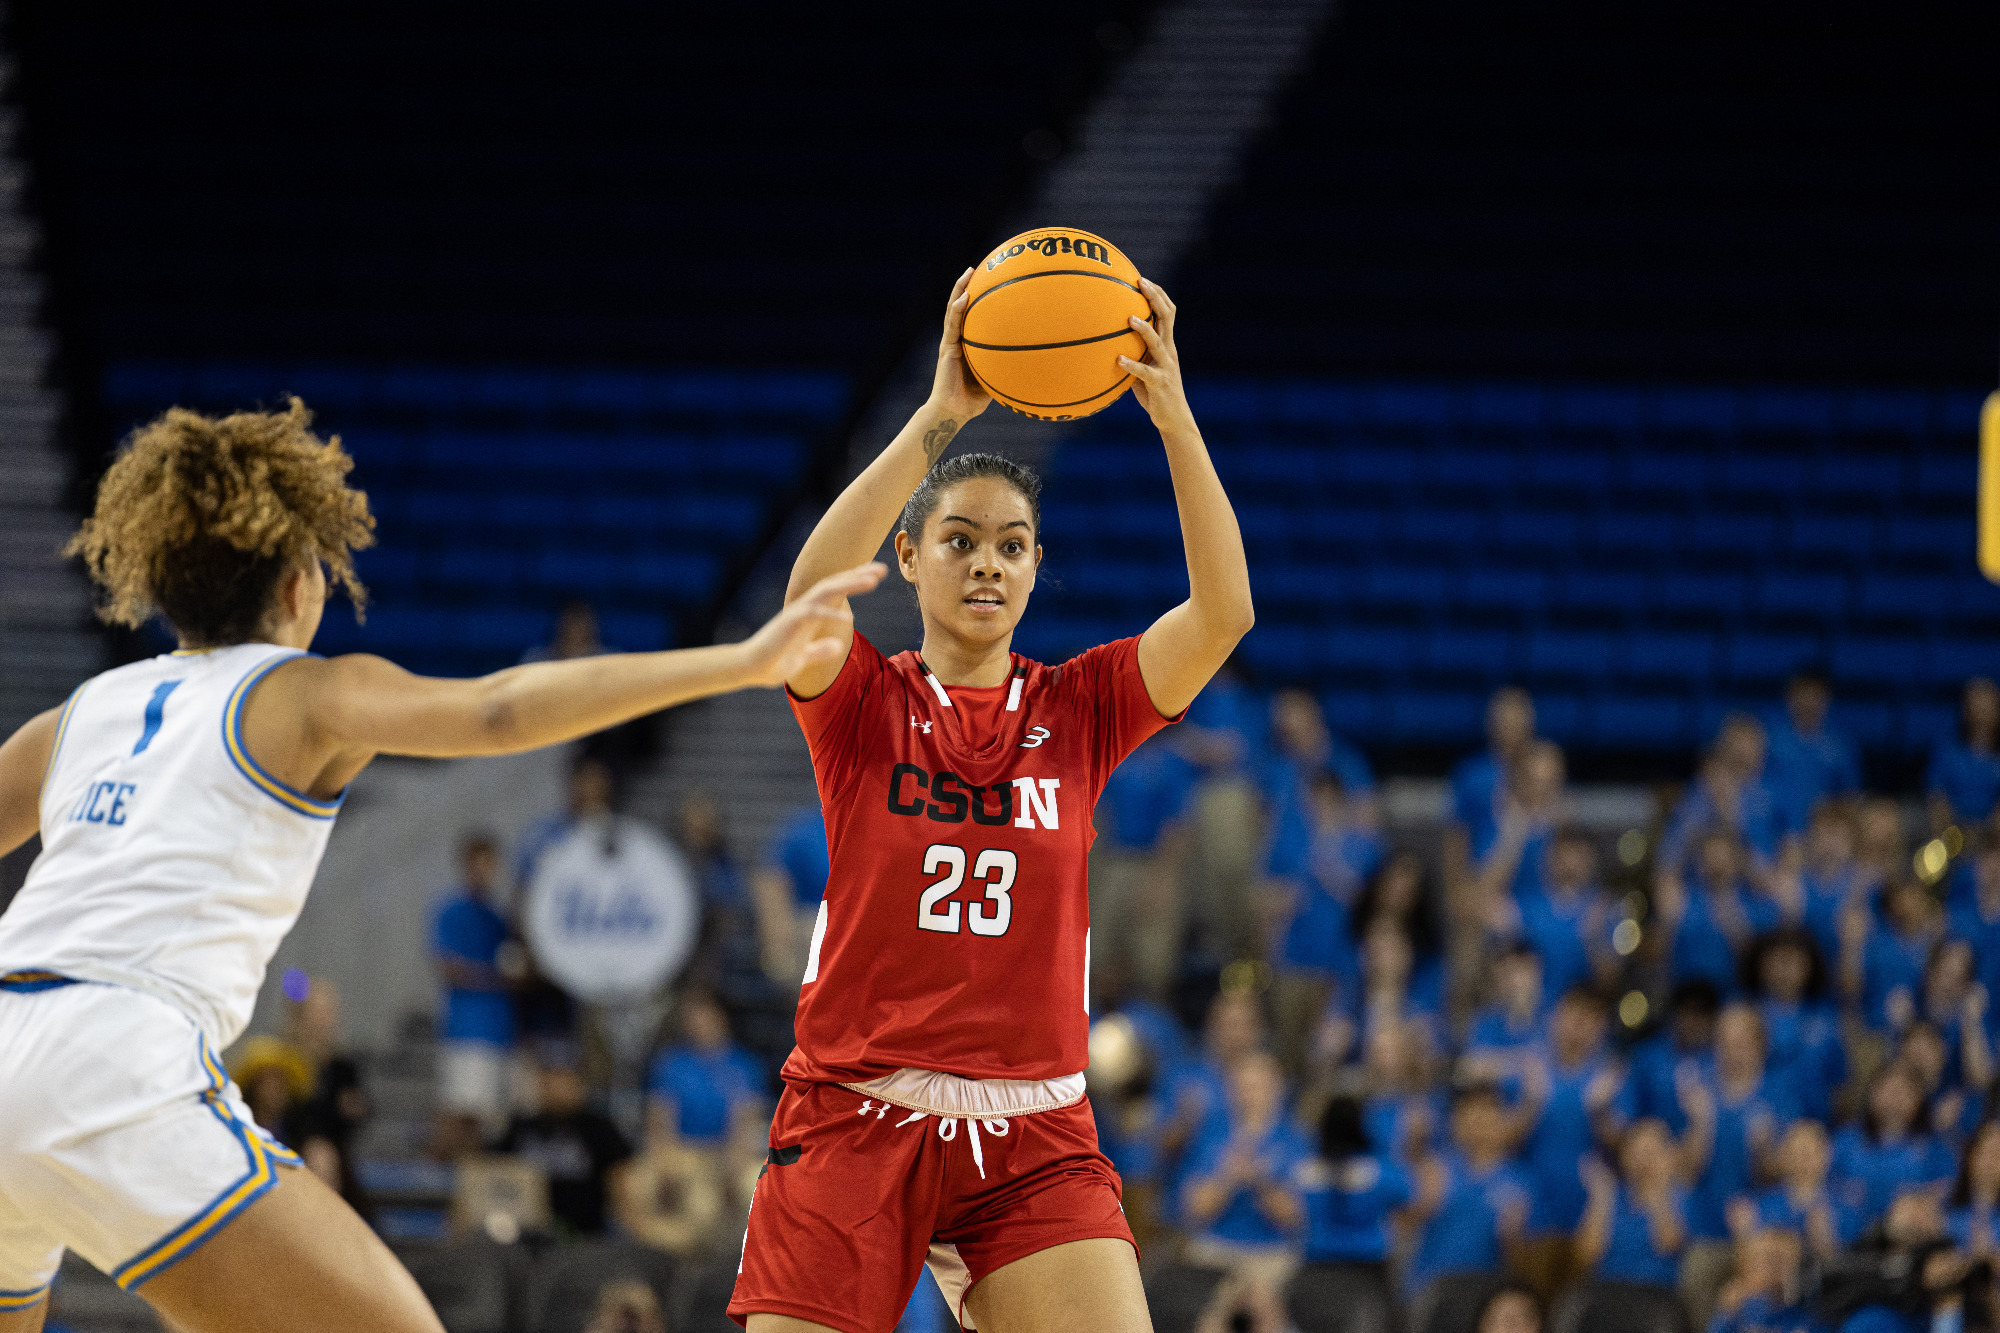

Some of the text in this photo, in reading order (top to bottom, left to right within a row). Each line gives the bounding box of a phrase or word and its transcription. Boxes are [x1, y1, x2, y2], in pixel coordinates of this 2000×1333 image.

[986, 236, 1112, 271] Wilson
[132, 678, 185, 758] 1
[887, 762, 1061, 830] CSUN
[916, 843, 1018, 938] 23
